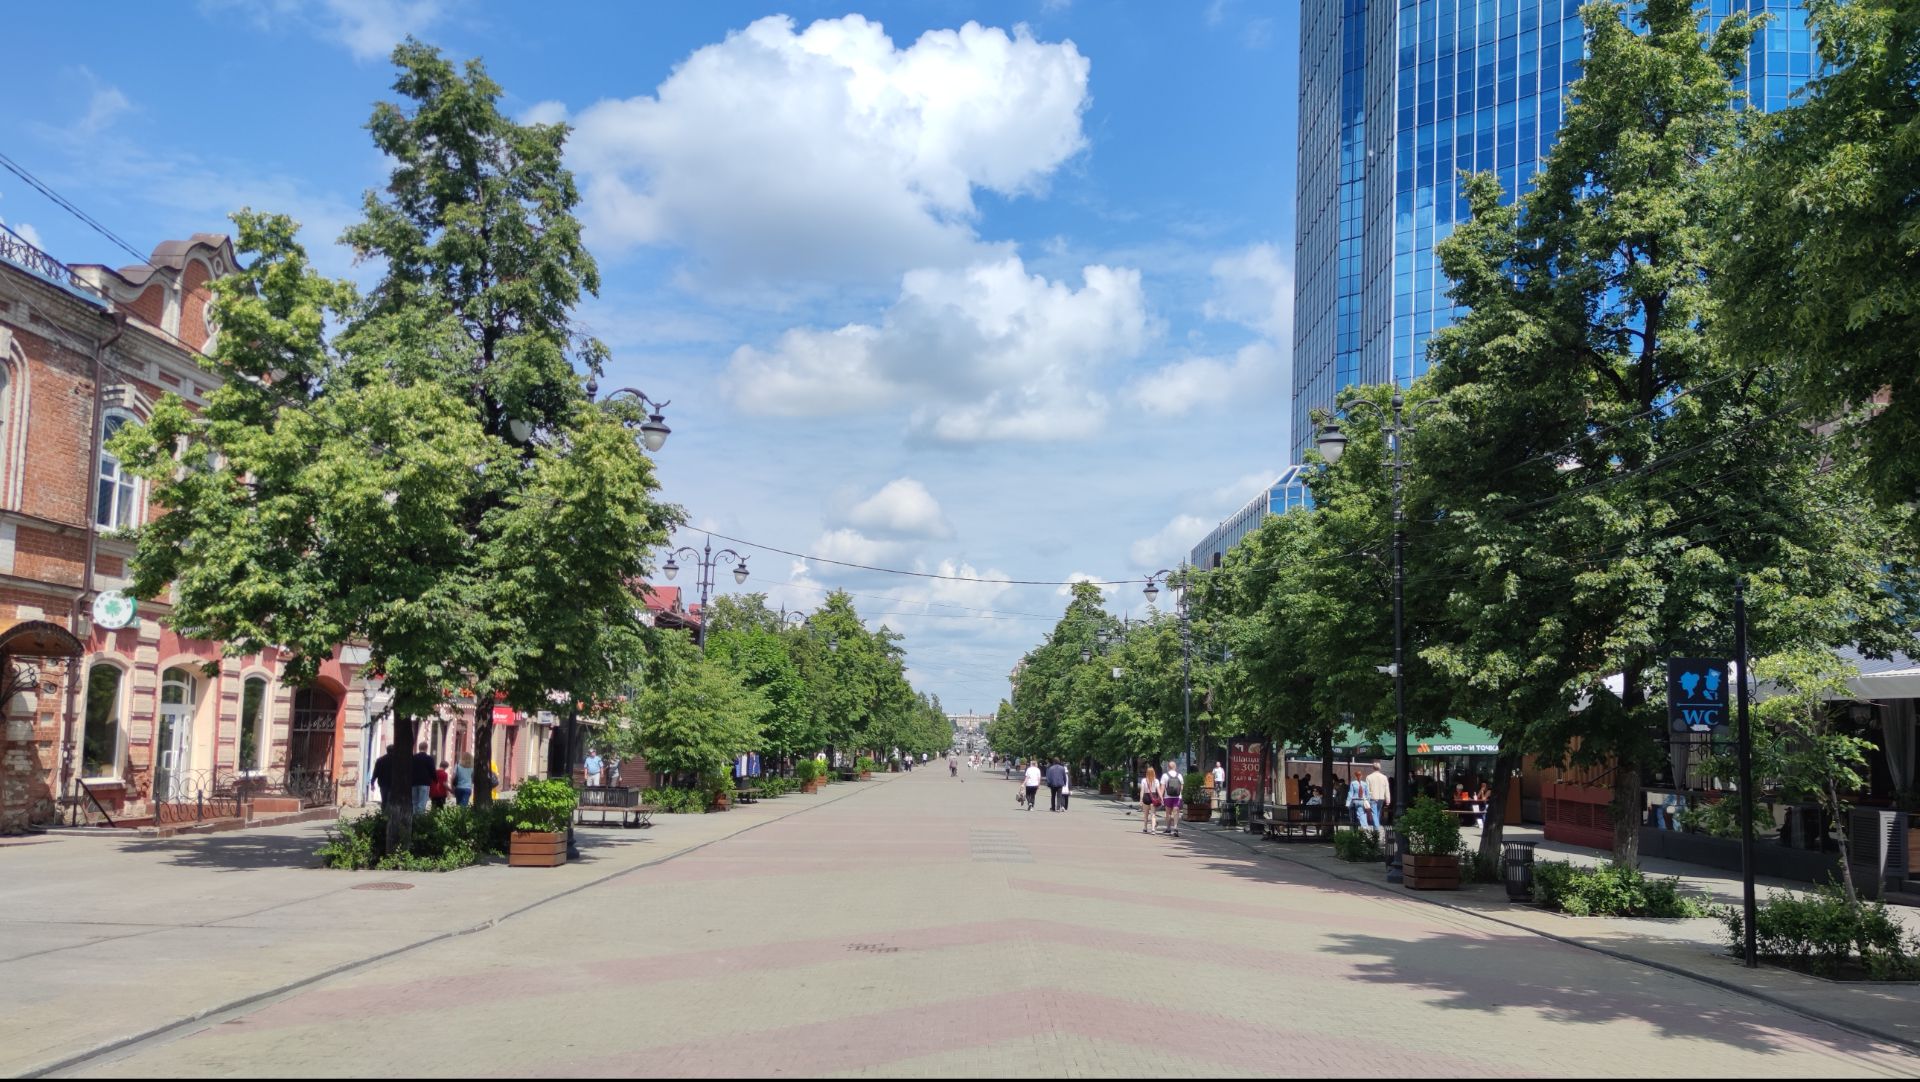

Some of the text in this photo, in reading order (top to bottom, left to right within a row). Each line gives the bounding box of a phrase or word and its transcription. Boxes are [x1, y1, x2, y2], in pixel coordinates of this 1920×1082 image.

[1681, 709, 1719, 726] WC
[1433, 744, 1463, 752] ВКУСНО
[1476, 744, 1500, 752] ТОЧКА
